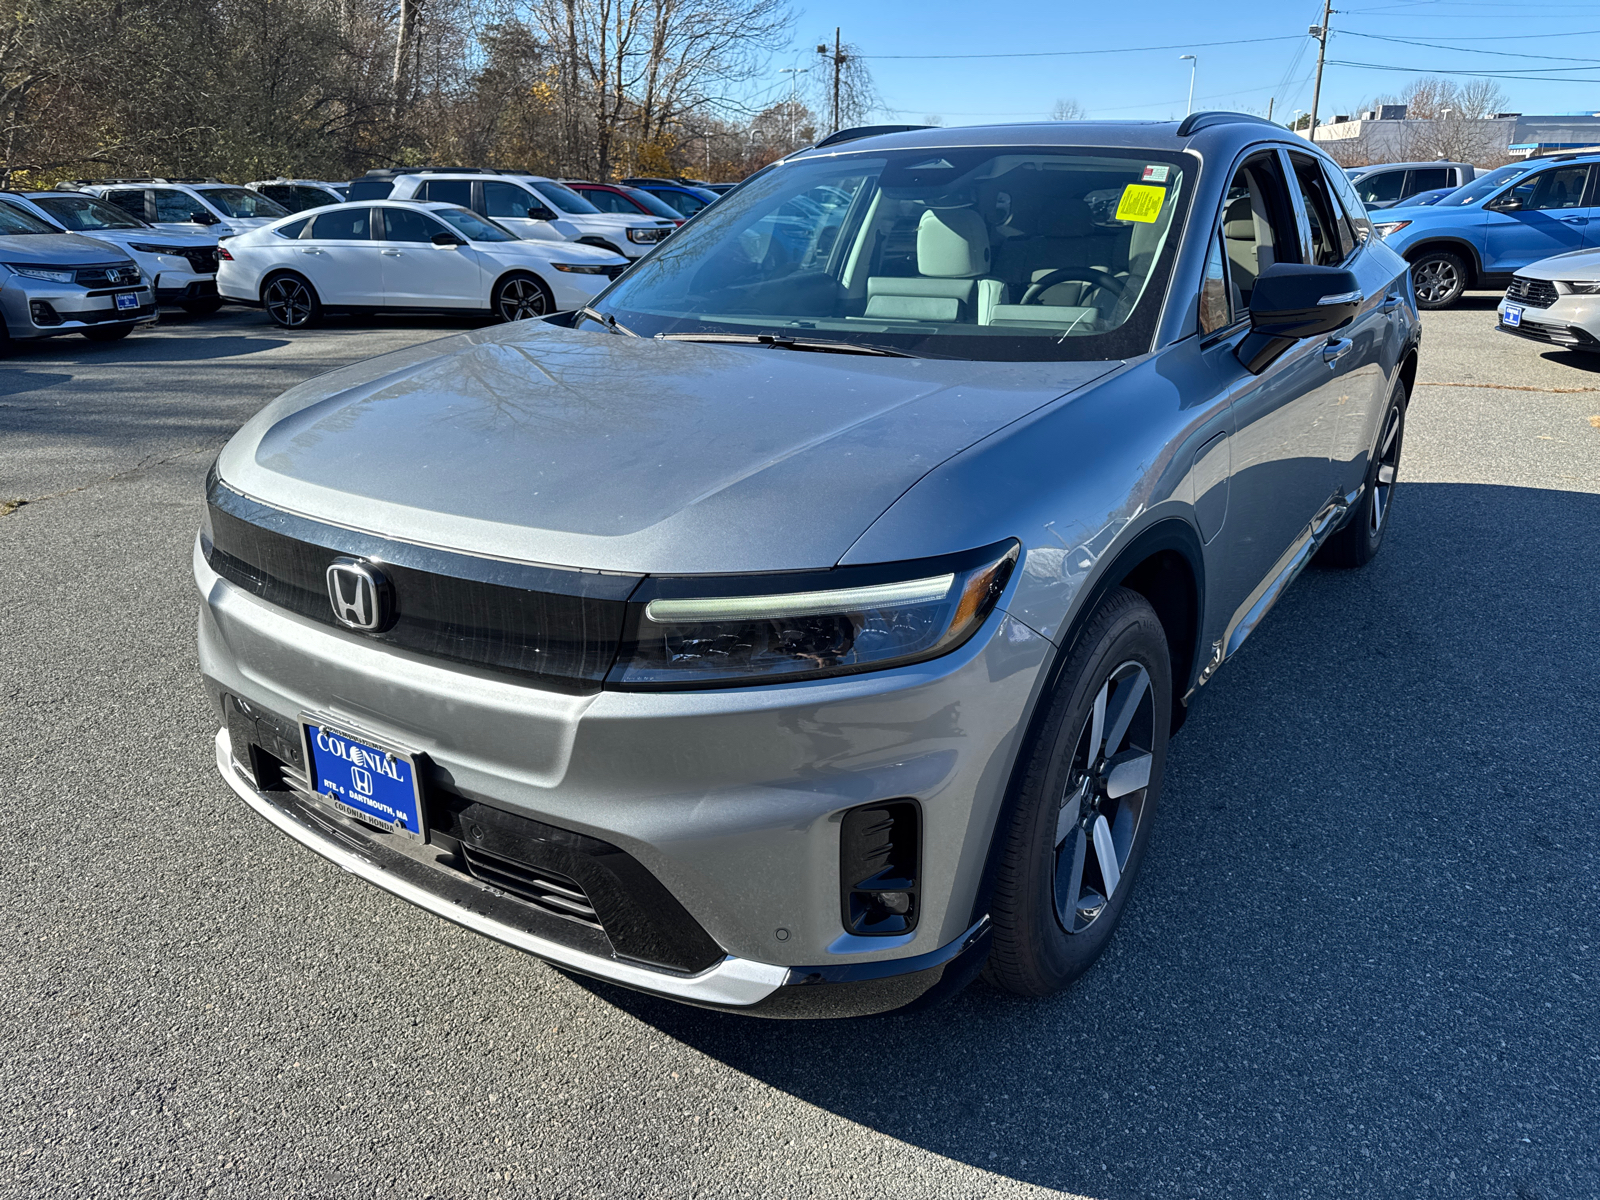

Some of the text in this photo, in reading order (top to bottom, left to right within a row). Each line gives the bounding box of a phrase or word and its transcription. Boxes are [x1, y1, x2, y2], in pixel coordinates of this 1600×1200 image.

[316, 732, 404, 782] COLONIAL
[323, 779, 345, 794] RTE. 6
[334, 801, 395, 833] COLONIAL HONDA
[349, 790, 408, 821] DARTMOUTH, MA
